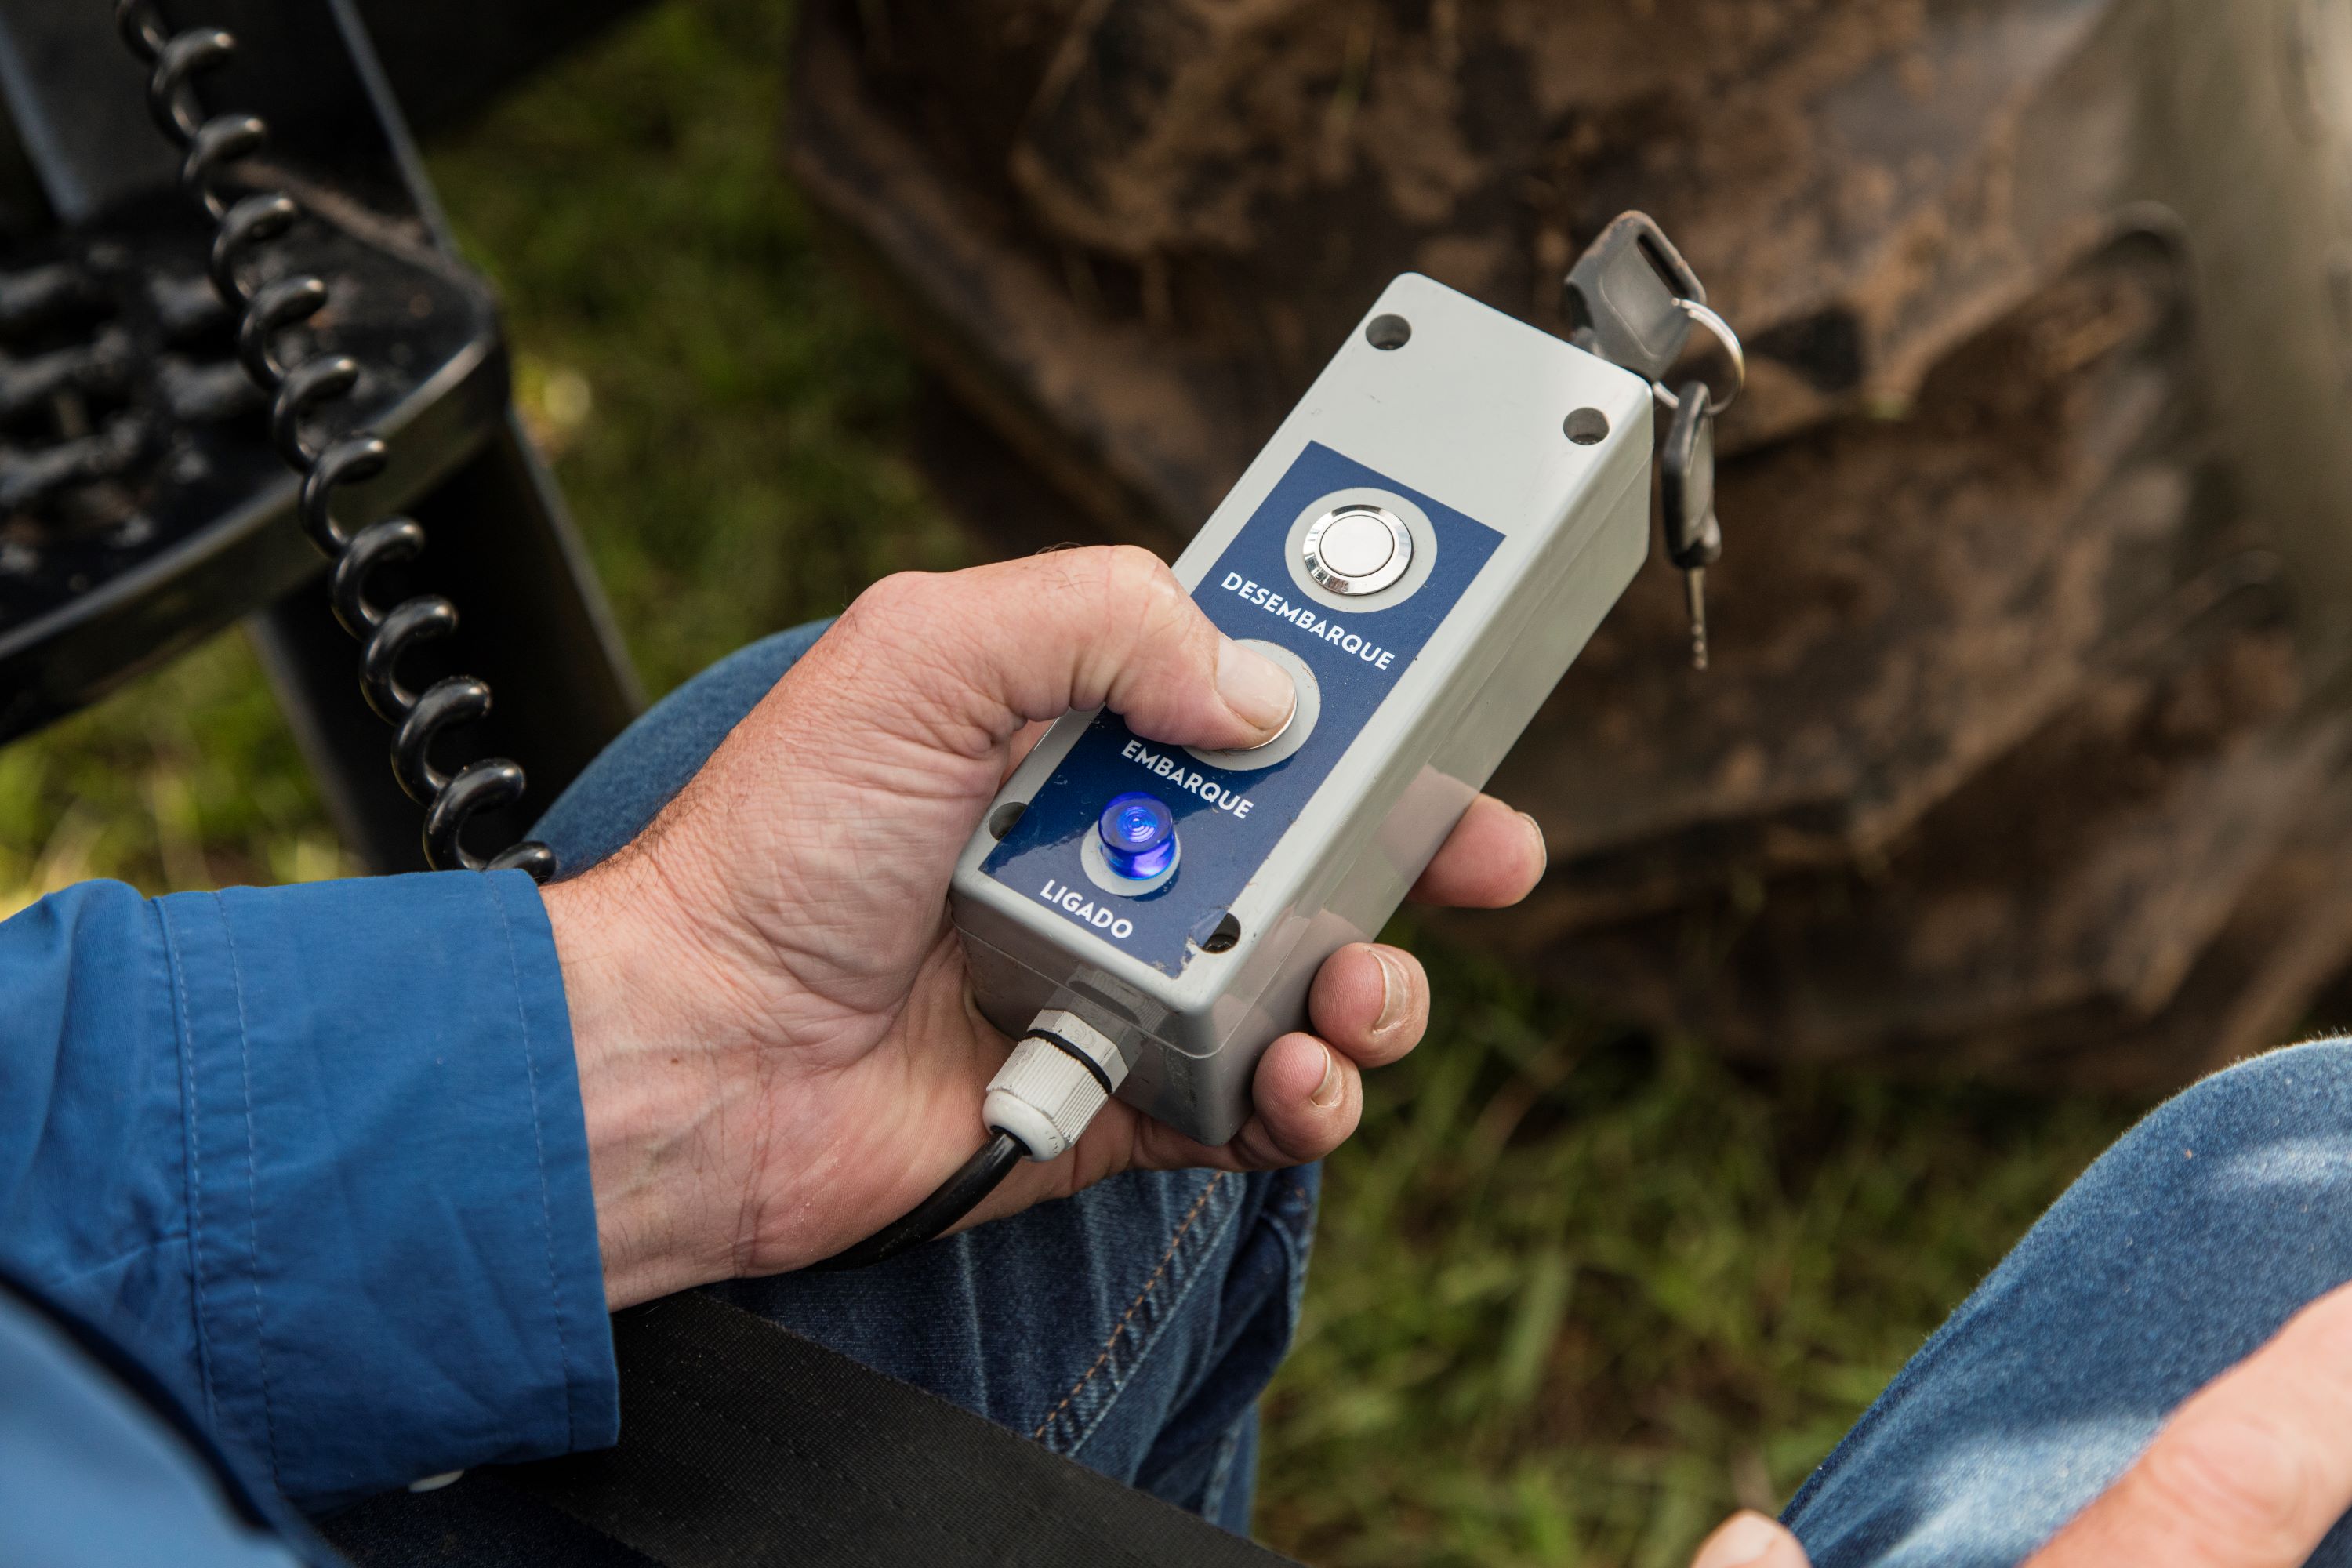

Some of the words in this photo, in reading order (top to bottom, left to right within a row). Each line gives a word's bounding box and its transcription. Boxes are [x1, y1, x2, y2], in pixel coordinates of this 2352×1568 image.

[1221, 572, 1396, 670] DESEMBARQUE
[1121, 739, 1254, 819] EMBARQUE
[1040, 879, 1133, 939] LIGADO
